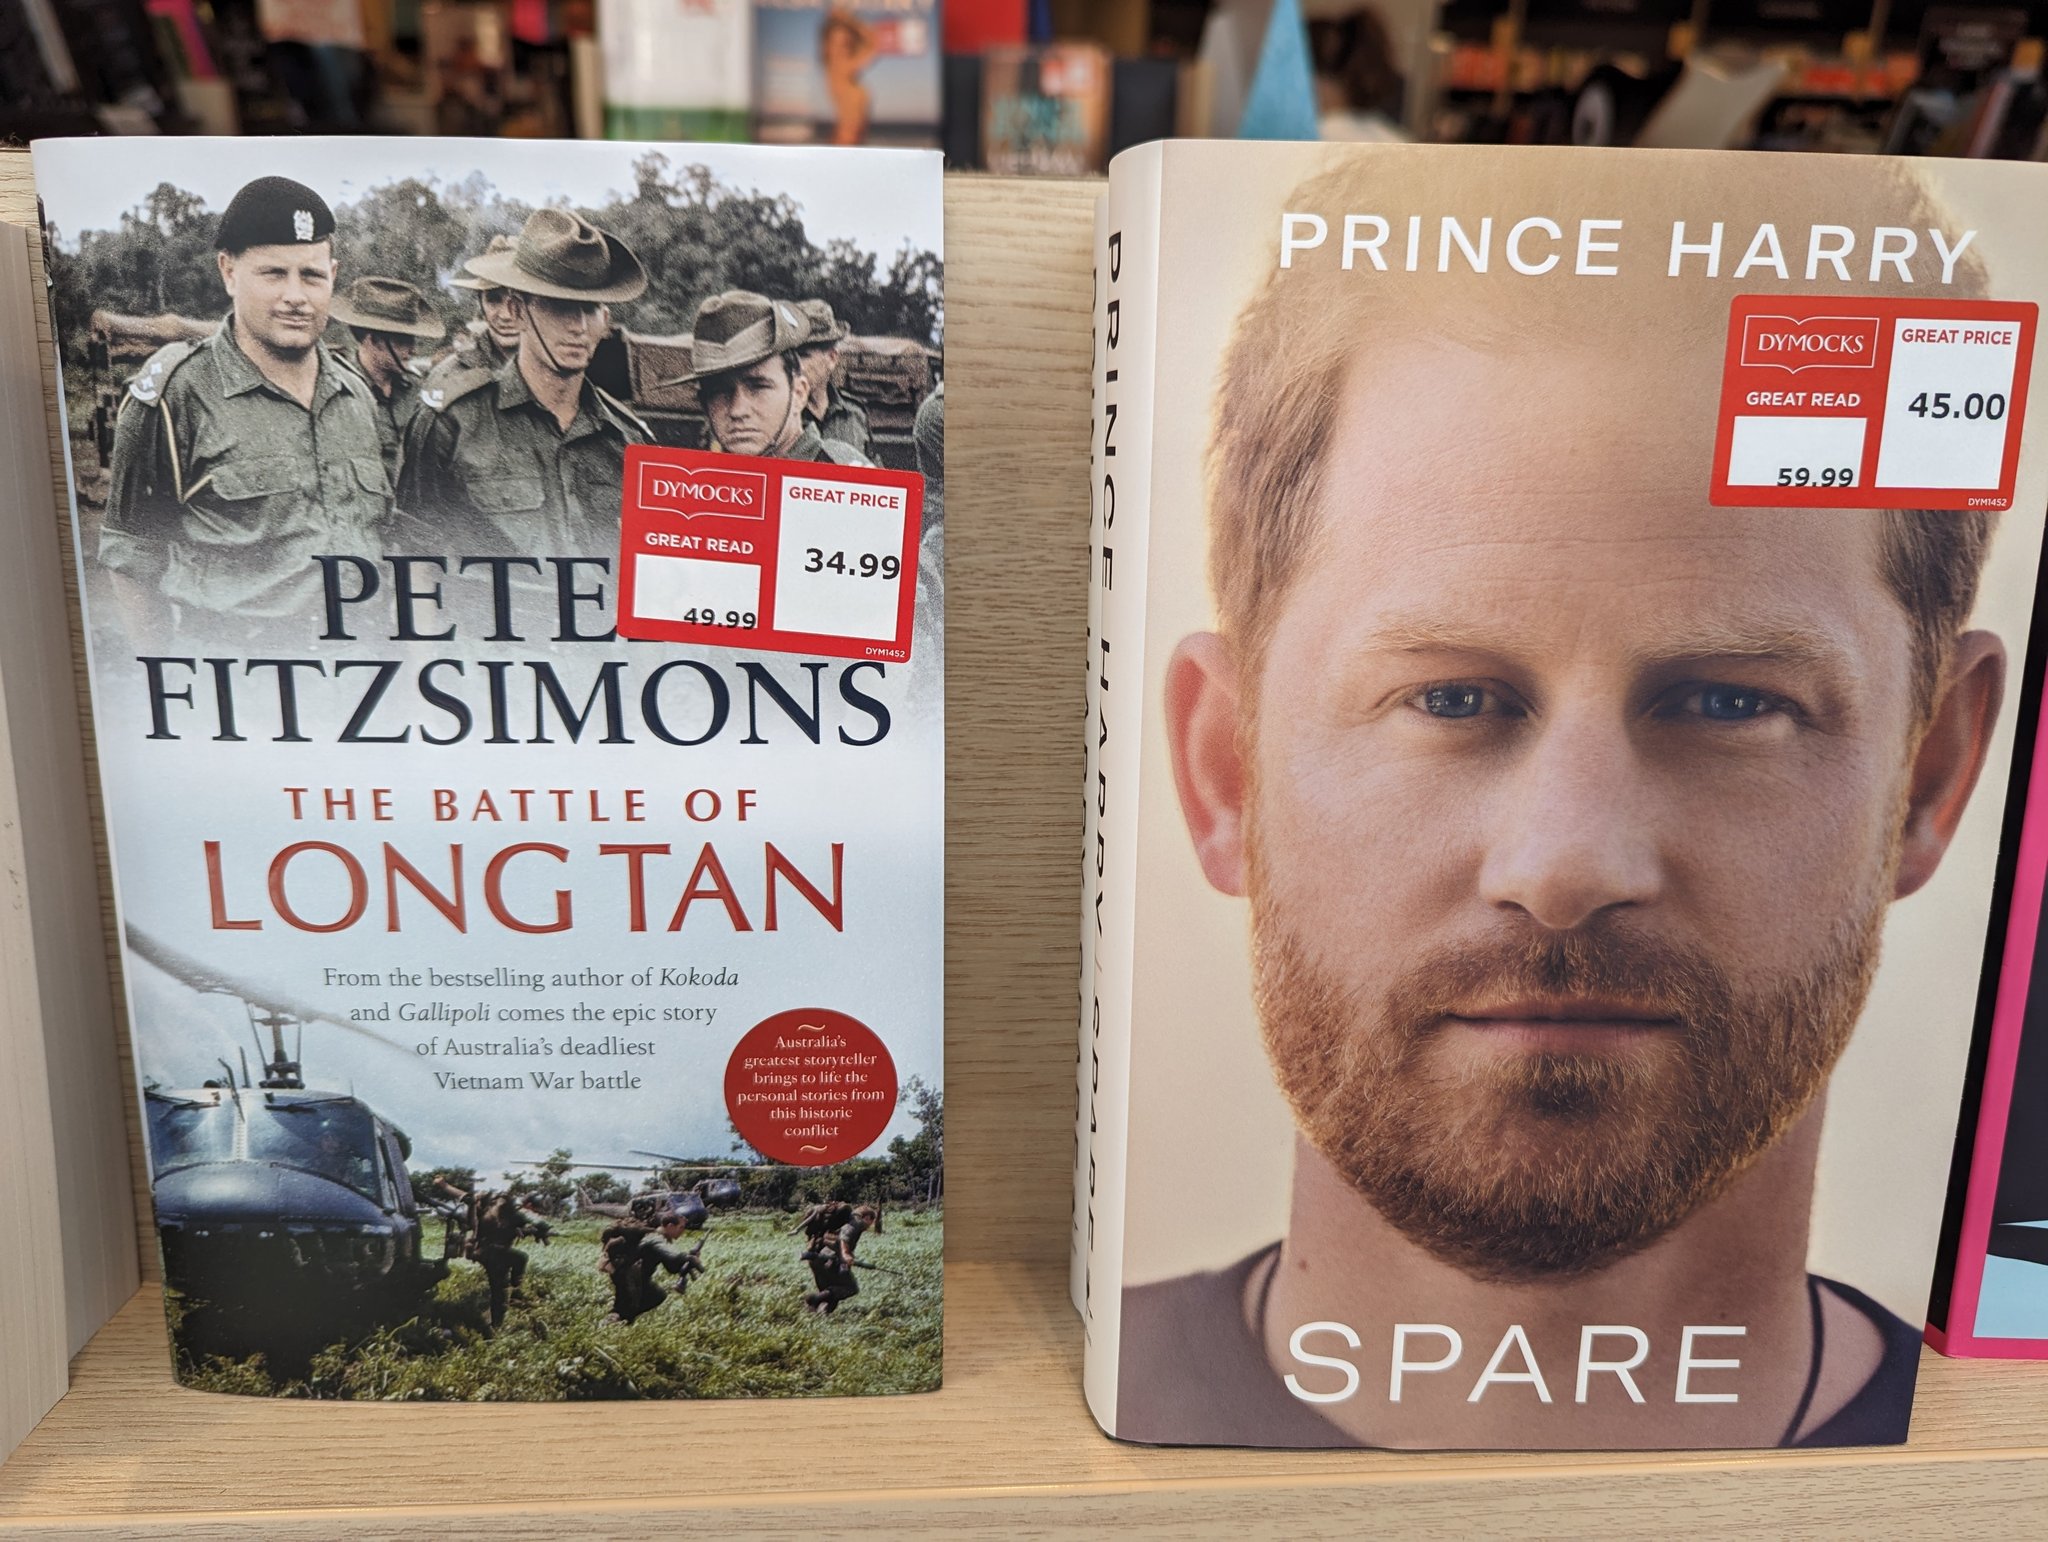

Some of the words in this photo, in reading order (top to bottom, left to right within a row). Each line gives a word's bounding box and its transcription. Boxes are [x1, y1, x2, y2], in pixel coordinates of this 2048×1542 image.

[1278, 213, 1623, 277] PRINCE
[1667, 221, 1979, 285] HARRY
[1758, 333, 1864, 354] DYMOCKS
[1901, 328, 1959, 345] GREAT
[1963, 331, 2012, 346] PRICE
[1746, 391, 1806, 407] GREAT
[1811, 393, 1861, 408] READ
[1908, 392, 2006, 421] 45.00
[1102, 231, 1122, 592] PRINCE
[1776, 467, 1854, 488] 59.99
[653, 479, 754, 506] DYMOCKS
[789, 486, 845, 504] GREAT
[849, 492, 899, 509] PRICE
[1967, 498, 2007, 507] DYM1452
[645, 532, 702, 550] GREAT
[707, 537, 754, 555] READ
[804, 548, 900, 580] 34.99
[311, 554, 664, 642] PETE
[684, 608, 757, 630] 49.99
[865, 646, 905, 658] DYM1452
[136, 656, 892, 746] FITZSIMONS
[284, 788, 393, 821] THE
[434, 789, 646, 822] BATTLE
[685, 789, 758, 822] OF
[204, 840, 573, 934] LONG
[598, 842, 844, 934] TAN
[323, 968, 380, 987] From
[389, 967, 422, 987] the
[429, 967, 546, 991] bestselling
[552, 967, 623, 987] author
[631, 967, 653, 987] of
[659, 967, 739, 987] Kokoda
[351, 1003, 391, 1021] and
[398, 1001, 491, 1026] Gallipoli
[497, 1007, 565, 1021] comes
[572, 1002, 605, 1021] the
[612, 1004, 656, 1026] epic
[663, 1005, 717, 1026] story
[416, 1037, 440, 1056] of
[444, 1037, 553, 1056] Australia’s
[560, 1037, 656, 1056] deadliest
[775, 1035, 847, 1048] Australia’s
[744, 1056, 800, 1069] greatest
[804, 1053, 877, 1068] storyteller
[434, 1072, 523, 1090] Vietnam
[530, 1072, 575, 1090] War
[581, 1071, 642, 1090] battle
[754, 1072, 798, 1086] brings
[801, 1074, 815, 1083] to
[820, 1071, 841, 1083] life
[845, 1071, 868, 1083] the
[738, 1089, 797, 1104] personal
[801, 1090, 848, 1101] stories
[851, 1088, 885, 1100] from
[771, 1107, 796, 1119] this
[800, 1106, 853, 1119] historic
[784, 1124, 839, 1136] conflict
[1283, 1321, 1746, 1403] SPARE
